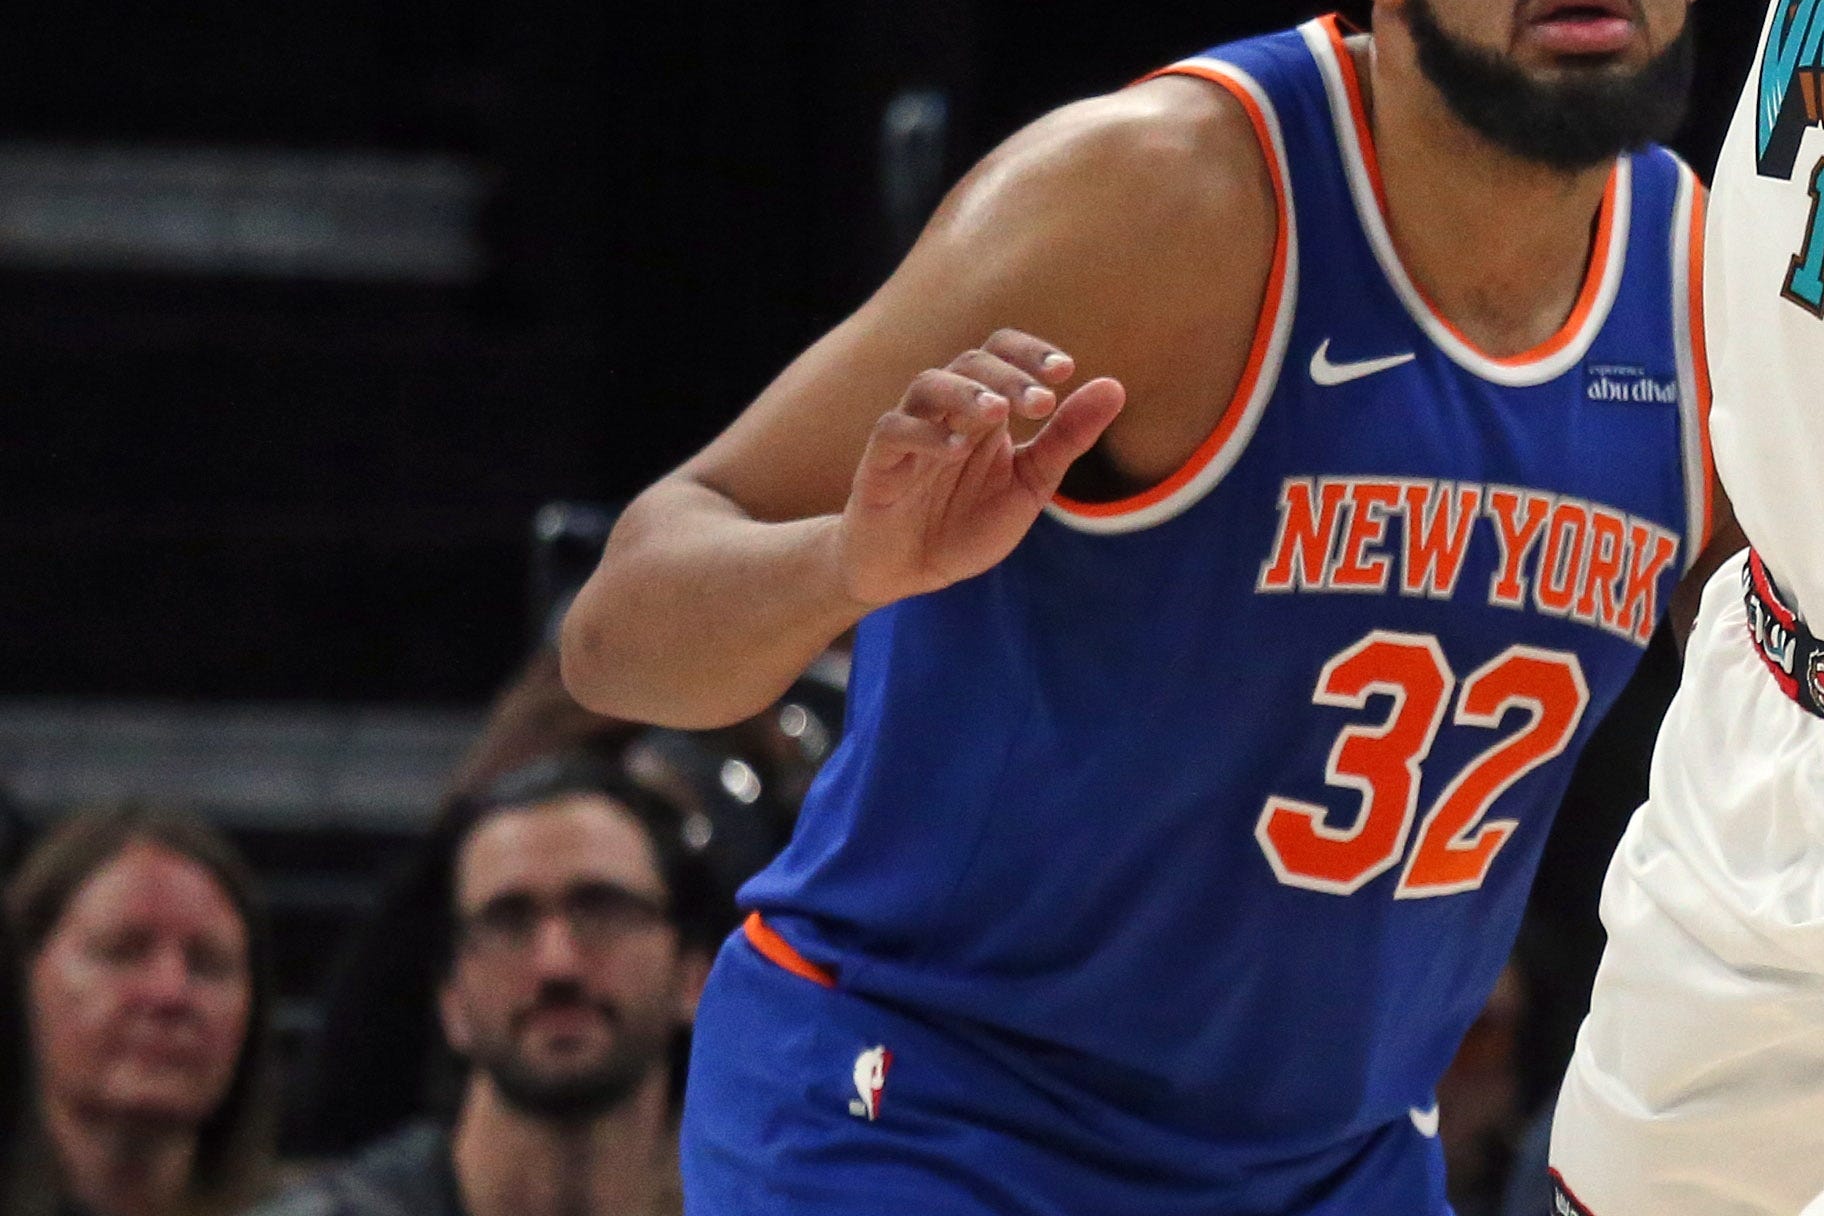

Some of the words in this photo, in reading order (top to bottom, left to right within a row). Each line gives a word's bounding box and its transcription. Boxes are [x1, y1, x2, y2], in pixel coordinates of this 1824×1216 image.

[1586, 377, 1629, 402] abu
[1631, 378, 1679, 403] dha
[1255, 475, 1484, 600] NEW
[1485, 483, 1681, 648] YORK
[1254, 630, 1590, 900] 32
